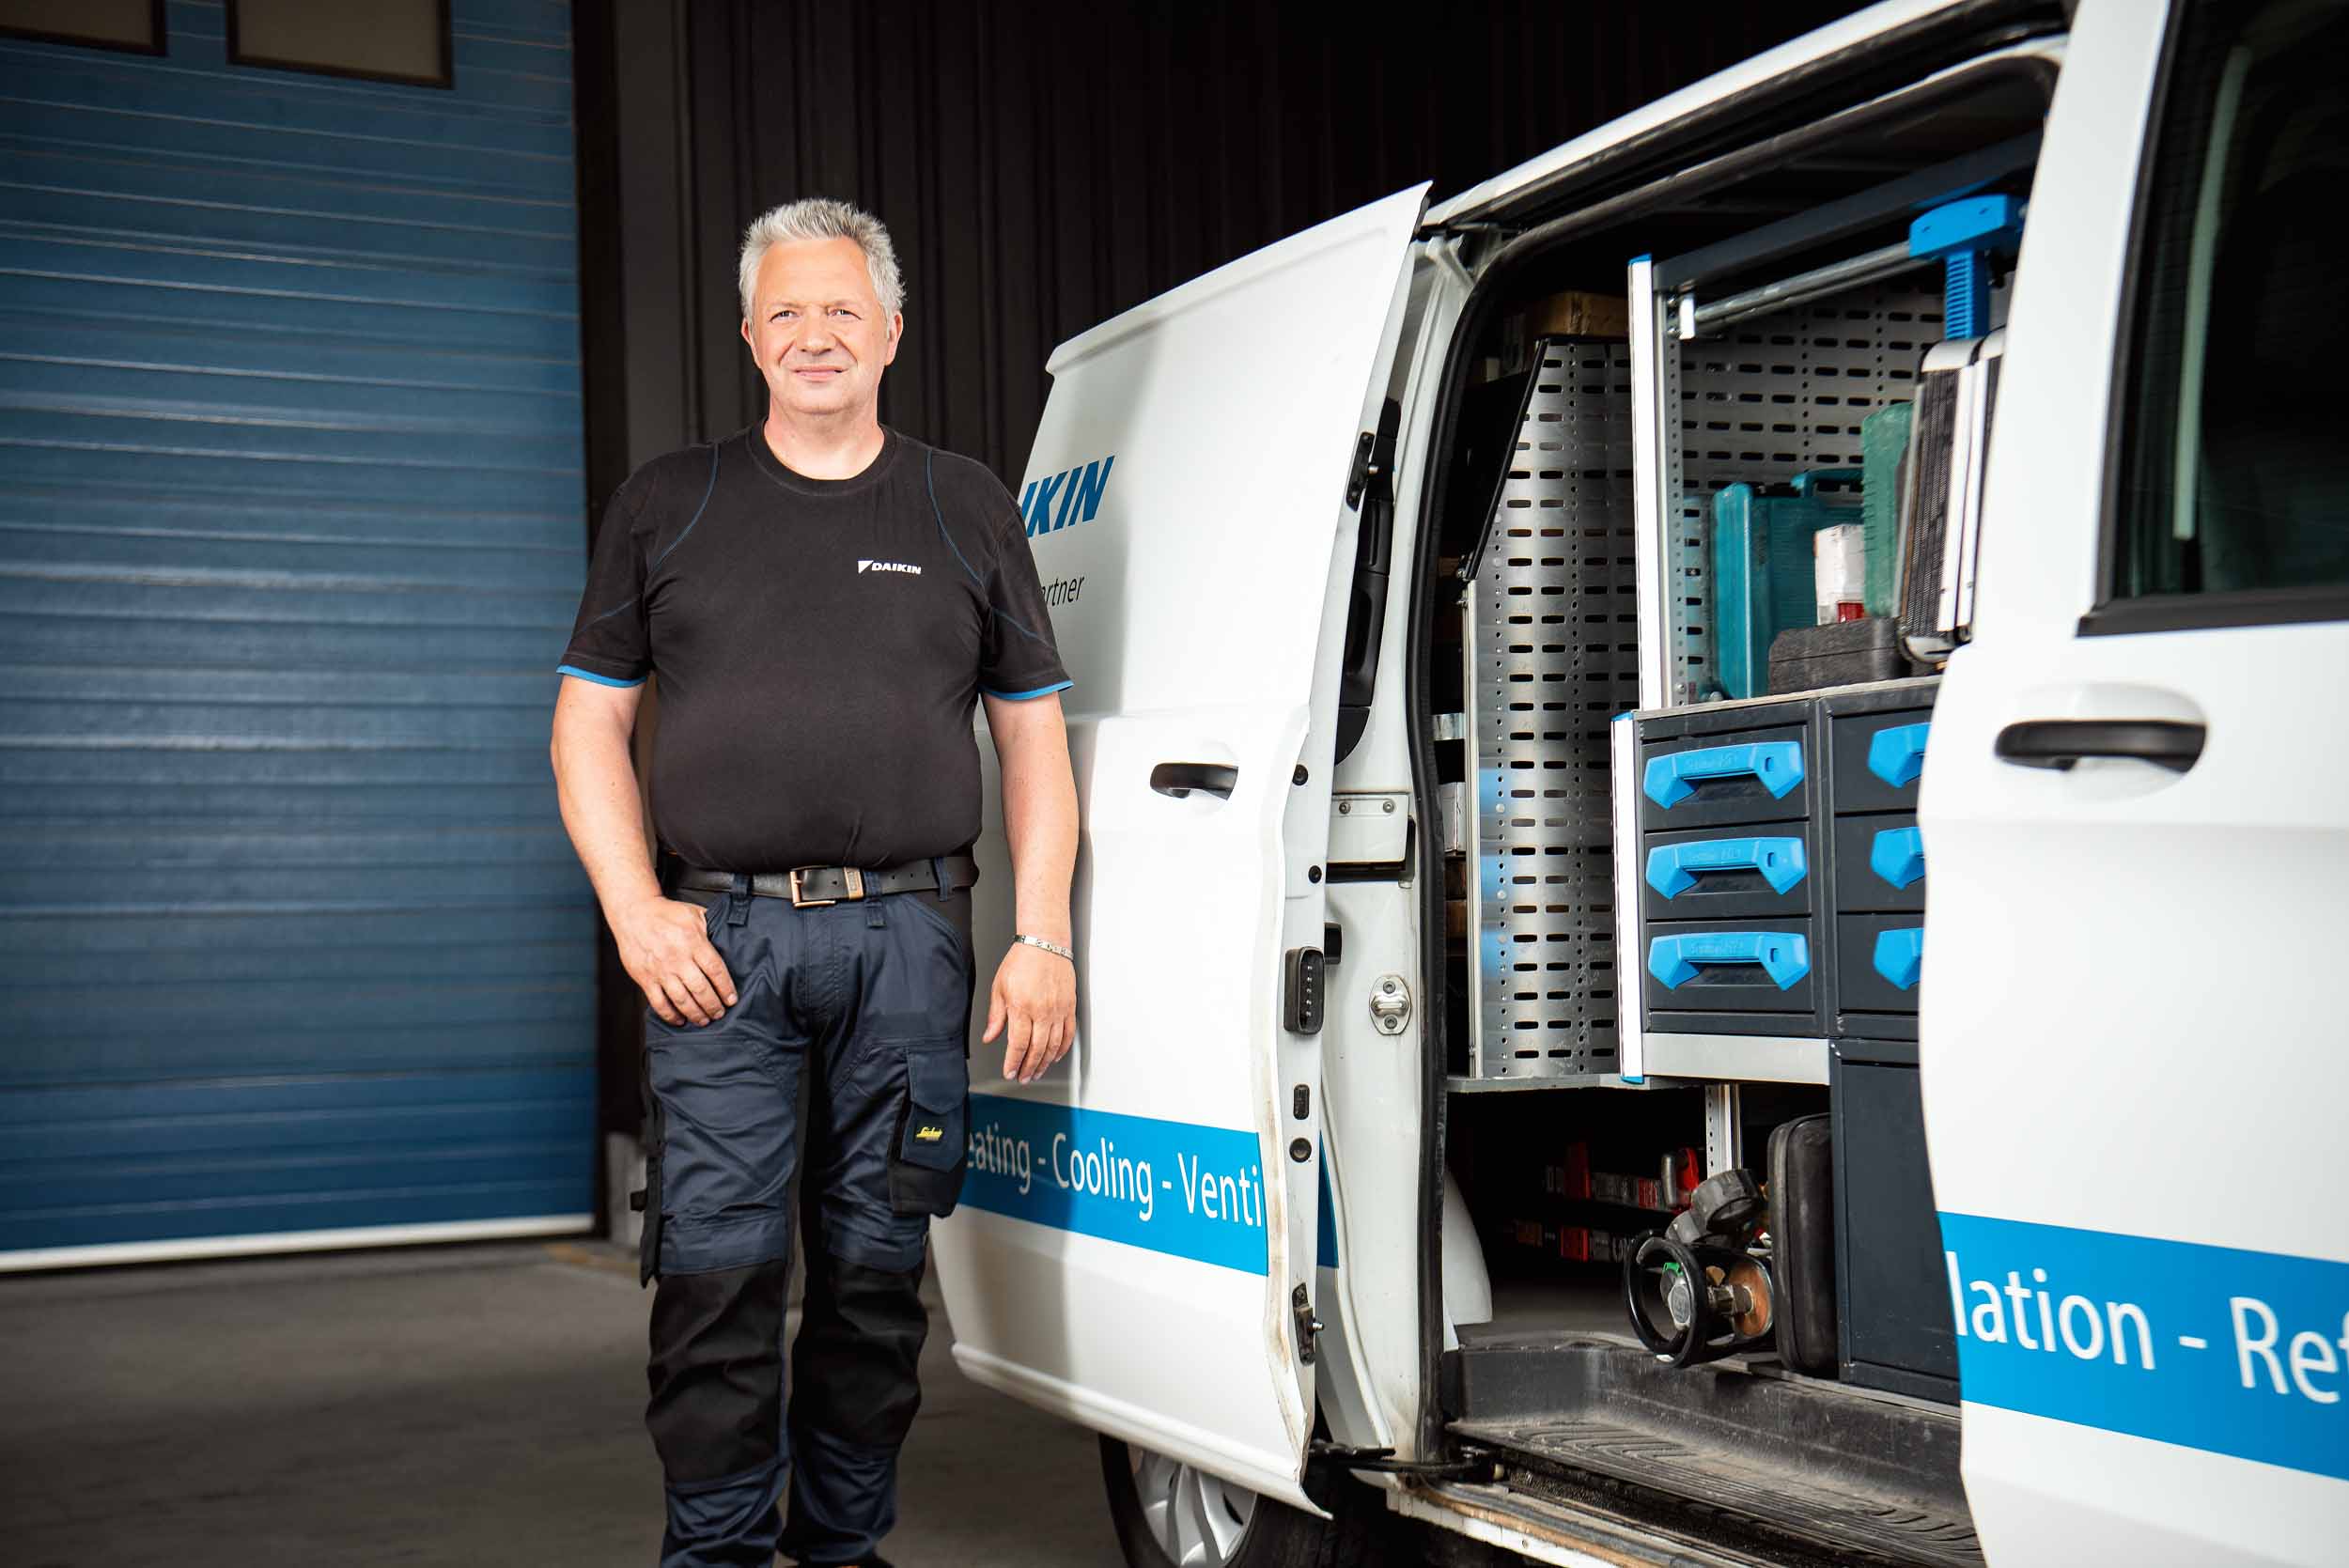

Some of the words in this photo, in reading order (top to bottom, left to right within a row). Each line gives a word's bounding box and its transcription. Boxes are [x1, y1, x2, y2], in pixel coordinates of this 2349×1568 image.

[871, 562, 922, 575] DAIKIN
[1052, 1133, 1154, 1221] Cooling
[1177, 1152, 1263, 1227] Venti
[1946, 1250, 2156, 1370] lation
